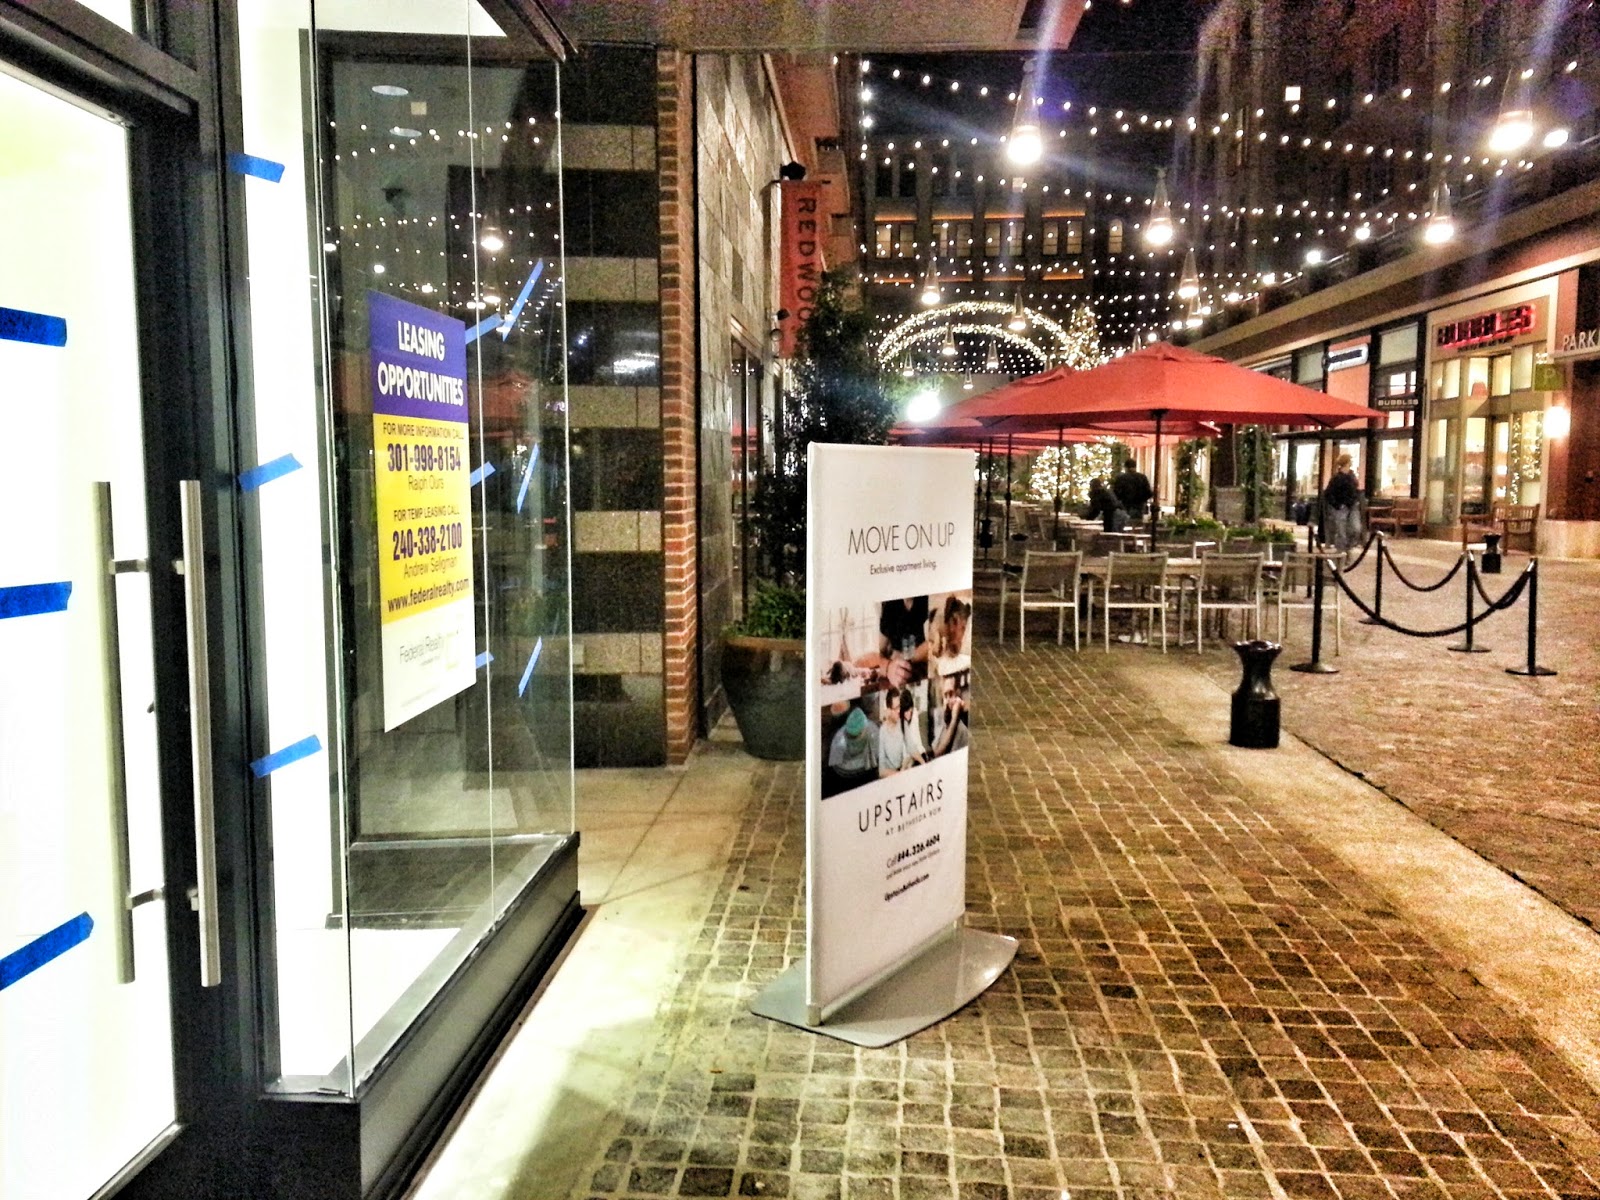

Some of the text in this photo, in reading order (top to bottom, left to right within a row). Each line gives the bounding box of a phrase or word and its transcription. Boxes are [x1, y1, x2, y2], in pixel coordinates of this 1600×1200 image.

[397, 320, 445, 361] LEASING
[377, 361, 464, 407] OPPORTUNITIES
[383, 422, 465, 440] FOR MORE INFORMATION CALL
[387, 442, 461, 472] 301-998-8154
[408, 474, 427, 491] Ralph
[393, 504, 460, 522] FOR TEMP LEASING CALL
[392, 522, 463, 561] 240-338-2100
[848, 522, 955, 556] MOVE ON UP
[403, 562, 429, 579] Andrew
[870, 562, 895, 575] Exclusive
[896, 560, 922, 573] apartment
[387, 578, 470, 613] www.federalrealty.com
[399, 637, 425, 664] Federal
[858, 778, 944, 833] UPSTAIRS
[885, 827, 894, 836] AT
